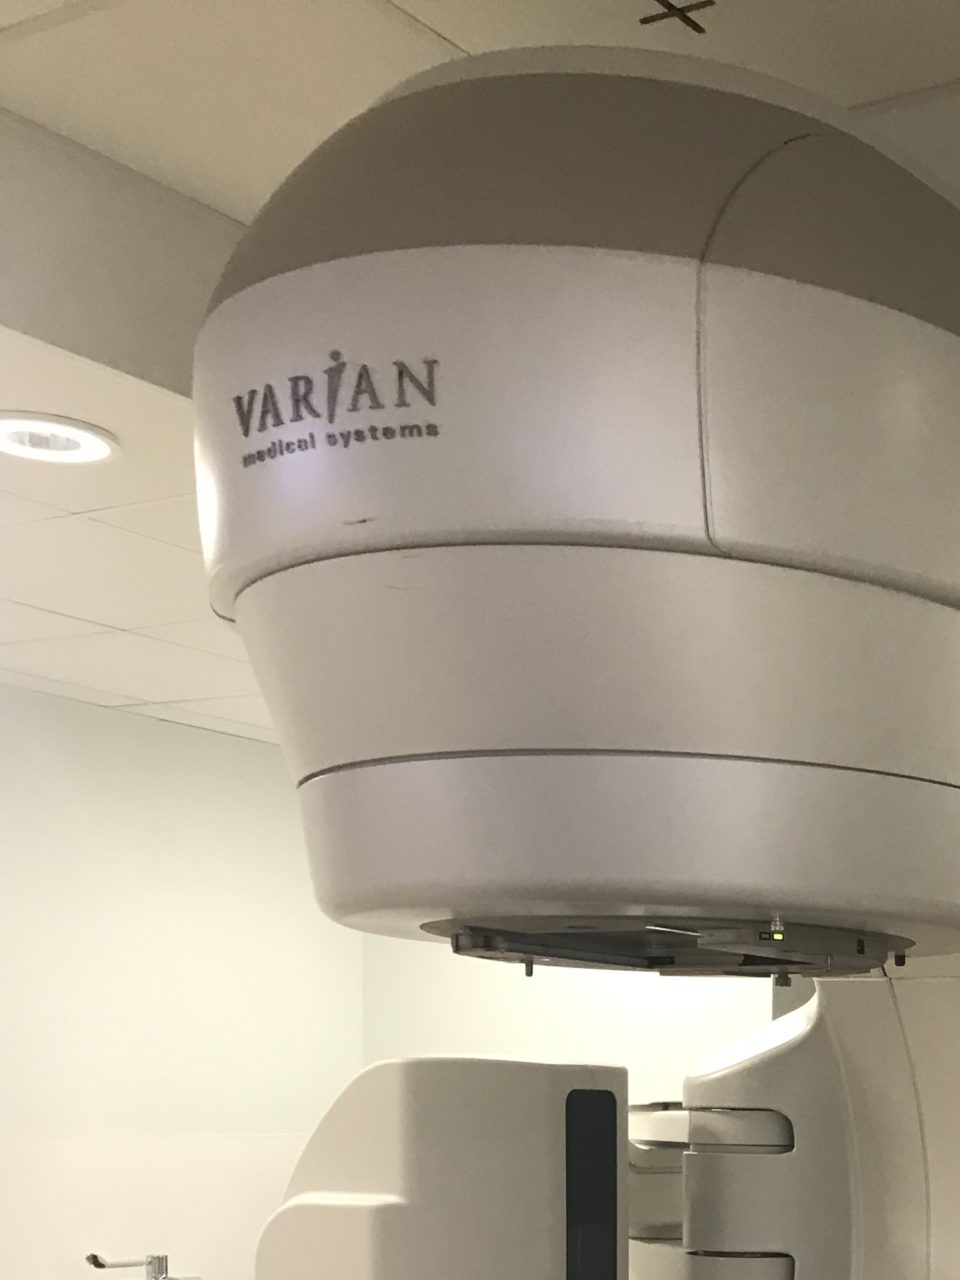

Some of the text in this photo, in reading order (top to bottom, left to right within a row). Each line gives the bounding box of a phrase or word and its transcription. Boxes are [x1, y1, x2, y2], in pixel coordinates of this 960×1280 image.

[232, 350, 440, 438] VARIAN
[242, 422, 440, 468] medical systems
